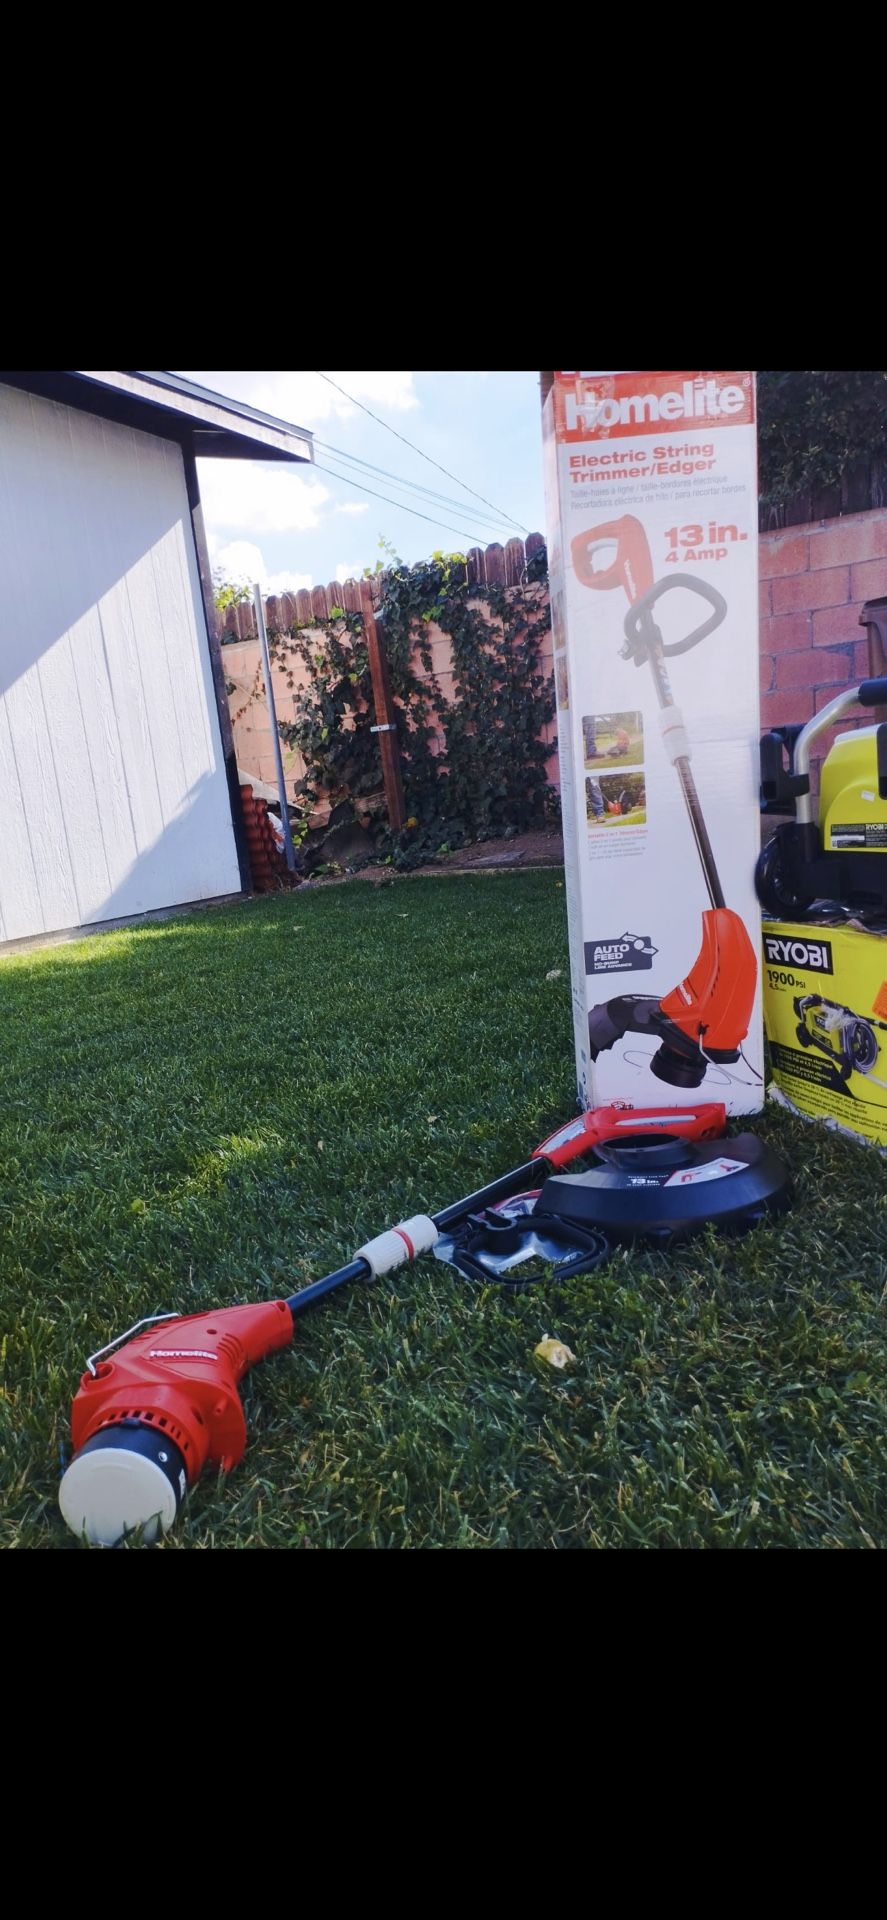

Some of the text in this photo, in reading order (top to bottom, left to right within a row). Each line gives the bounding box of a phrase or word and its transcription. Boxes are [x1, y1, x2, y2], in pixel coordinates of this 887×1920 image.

[565, 378, 746, 431] Homelite
[569, 443, 715, 469] Electric String
[569, 458, 717, 484] Trimmer/Edger
[664, 521, 748, 548] 13 in.
[665, 548, 728, 563] 4 Amp
[594, 944, 630, 955] AUTO
[594, 952, 624, 962] FEED
[765, 938, 829, 969] RYOBI
[767, 969, 806, 989] 1900 PSI
[150, 1350, 218, 1360] Homelite
